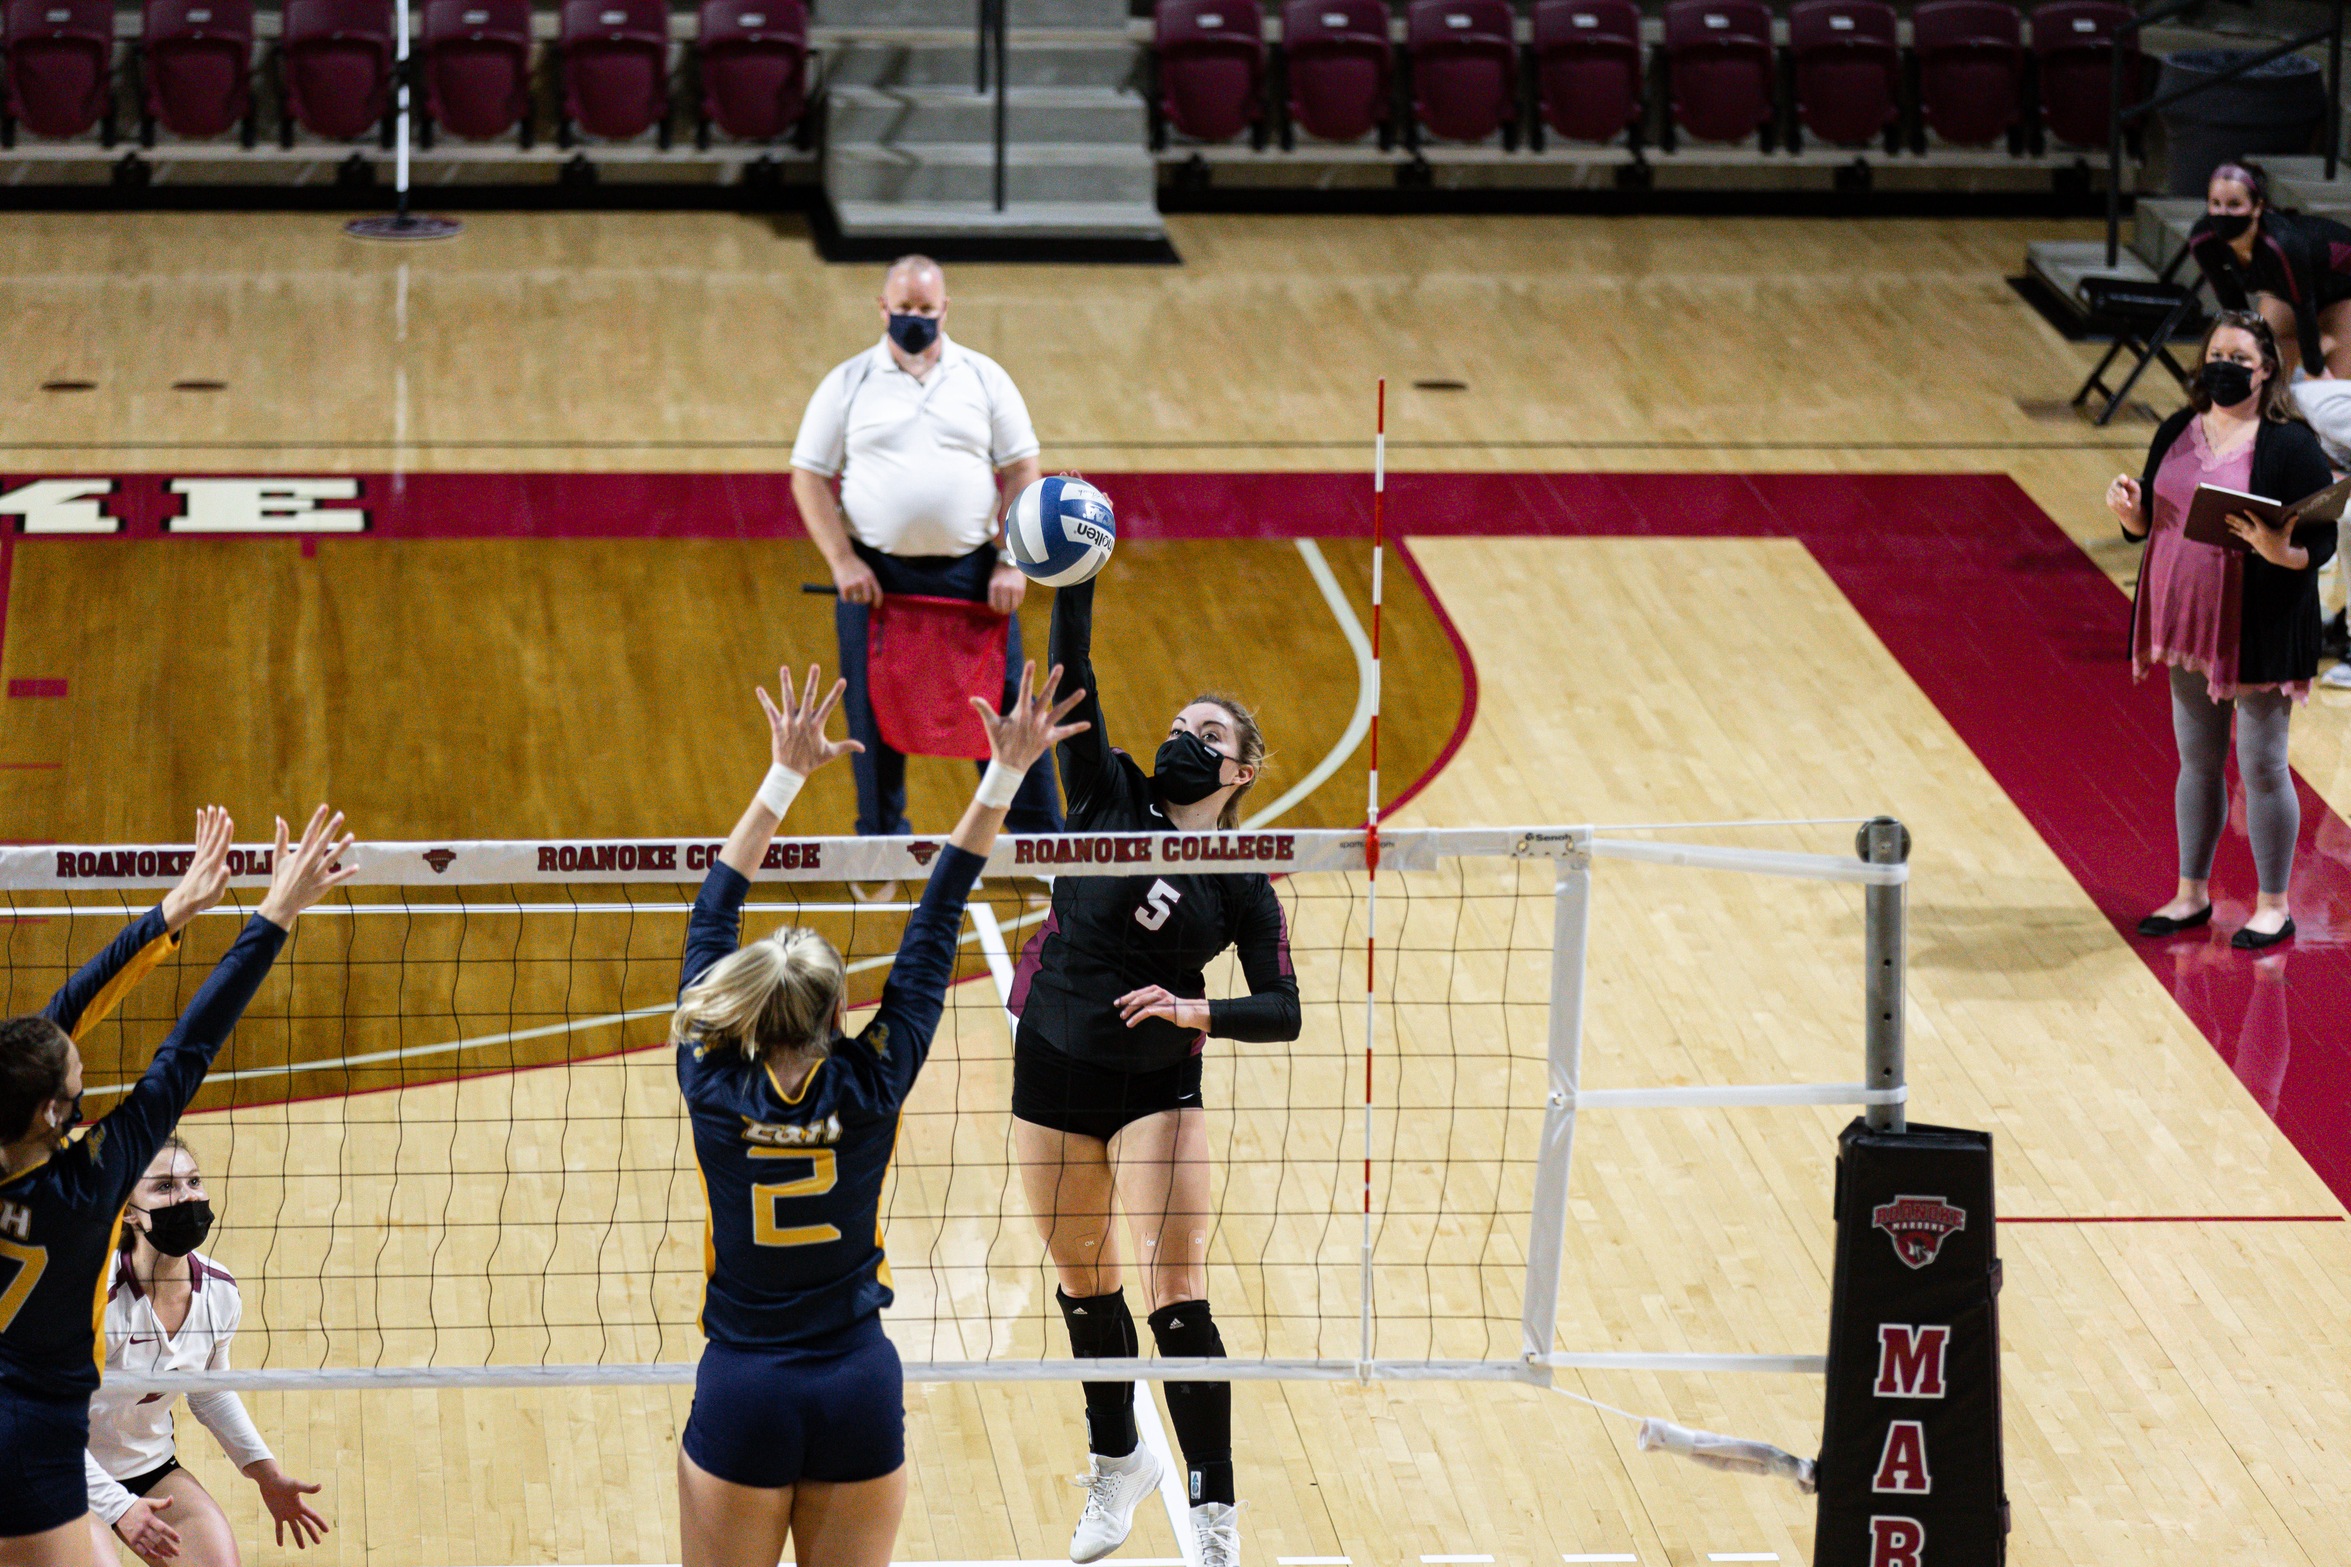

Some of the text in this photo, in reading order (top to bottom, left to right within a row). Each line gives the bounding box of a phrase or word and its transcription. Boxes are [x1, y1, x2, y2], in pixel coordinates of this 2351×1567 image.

[537, 843, 821, 872] ROANOKE COEGE
[1015, 835, 1295, 864] ROANOKE COLLEGE
[1133, 877, 1182, 932] 5
[746, 1146, 842, 1247] 2
[1892, 1221, 1945, 1232] MAROONS
